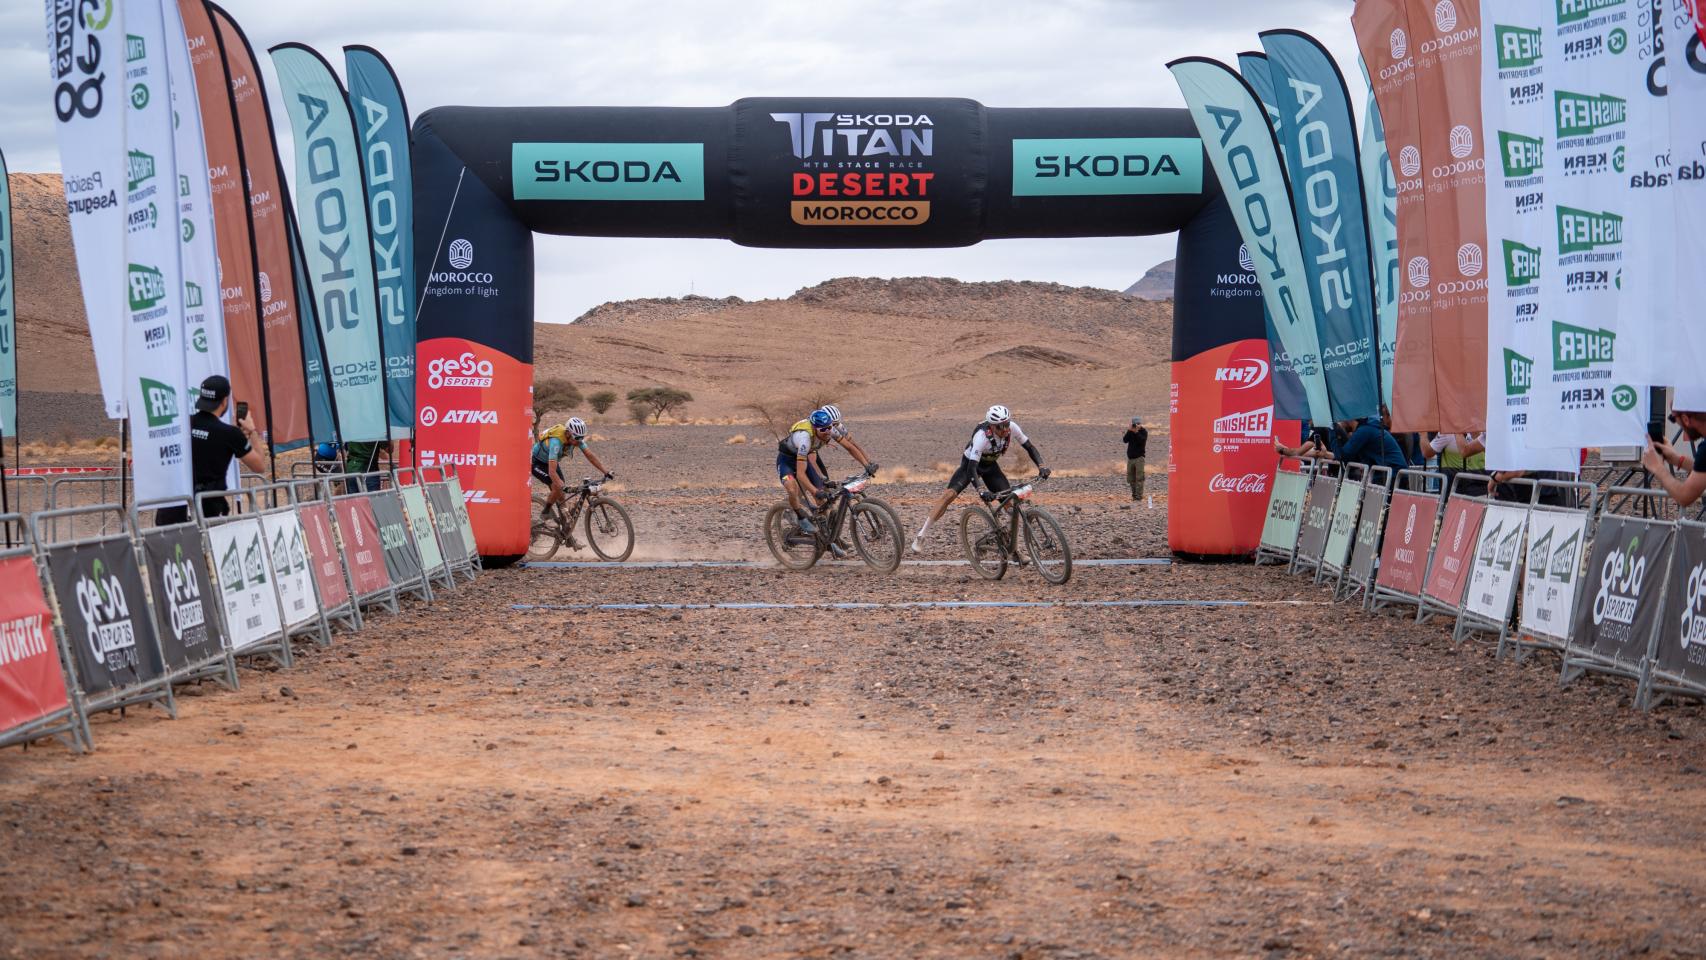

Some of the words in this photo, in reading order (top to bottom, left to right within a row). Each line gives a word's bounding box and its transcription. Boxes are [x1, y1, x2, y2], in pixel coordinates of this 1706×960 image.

[837, 114, 934, 126] SKODA
[769, 112, 933, 159] TITAN
[535, 161, 681, 183] SKODA
[1035, 155, 1180, 178] SKODA
[793, 173, 935, 196] DESERT
[803, 206, 918, 220] MOROCCO
[429, 272, 493, 284] MOROCCO
[1217, 274, 1261, 285] MORO
[465, 286, 475, 295] of
[477, 286, 499, 297] light
[1210, 287, 1252, 299] Kingdom
[446, 378, 490, 386] SPORTS
[441, 409, 499, 424] ATIKA
[1215, 412, 1269, 432] FINISHER
[438, 453, 497, 466] WÜRTH
[1606, 596, 1635, 621] SPORTS
